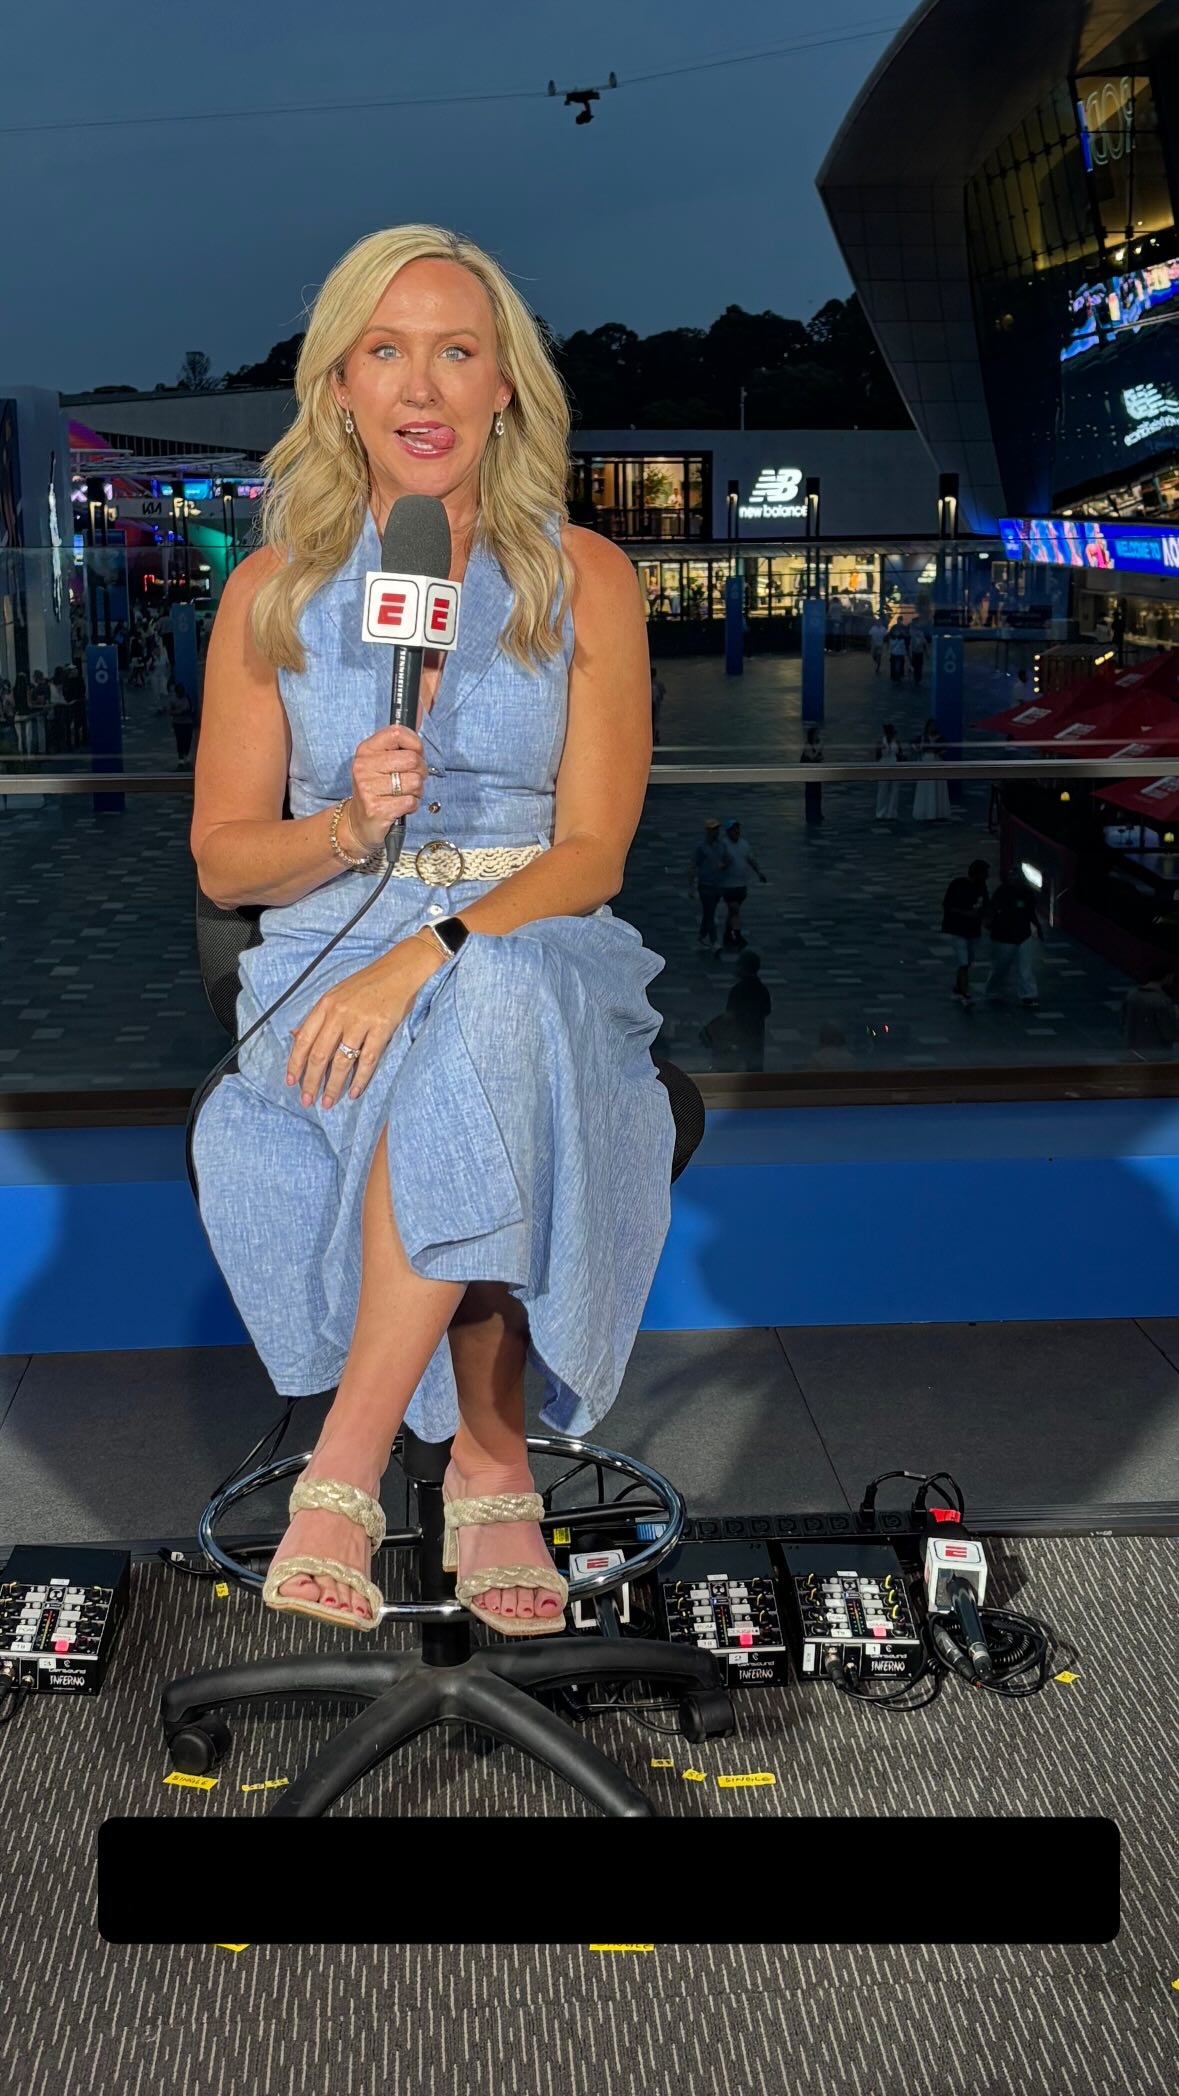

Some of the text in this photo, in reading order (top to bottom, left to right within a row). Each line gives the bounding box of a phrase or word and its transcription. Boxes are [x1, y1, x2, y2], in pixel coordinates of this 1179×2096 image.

[739, 504, 808, 518] new balance
[377, 592, 407, 626] E
[430, 597, 450, 632] E
[871, 1660, 906, 1672] INFERNO
[50, 1675, 85, 1686] INFERNO
[739, 1668, 774, 1680] INFERNO
